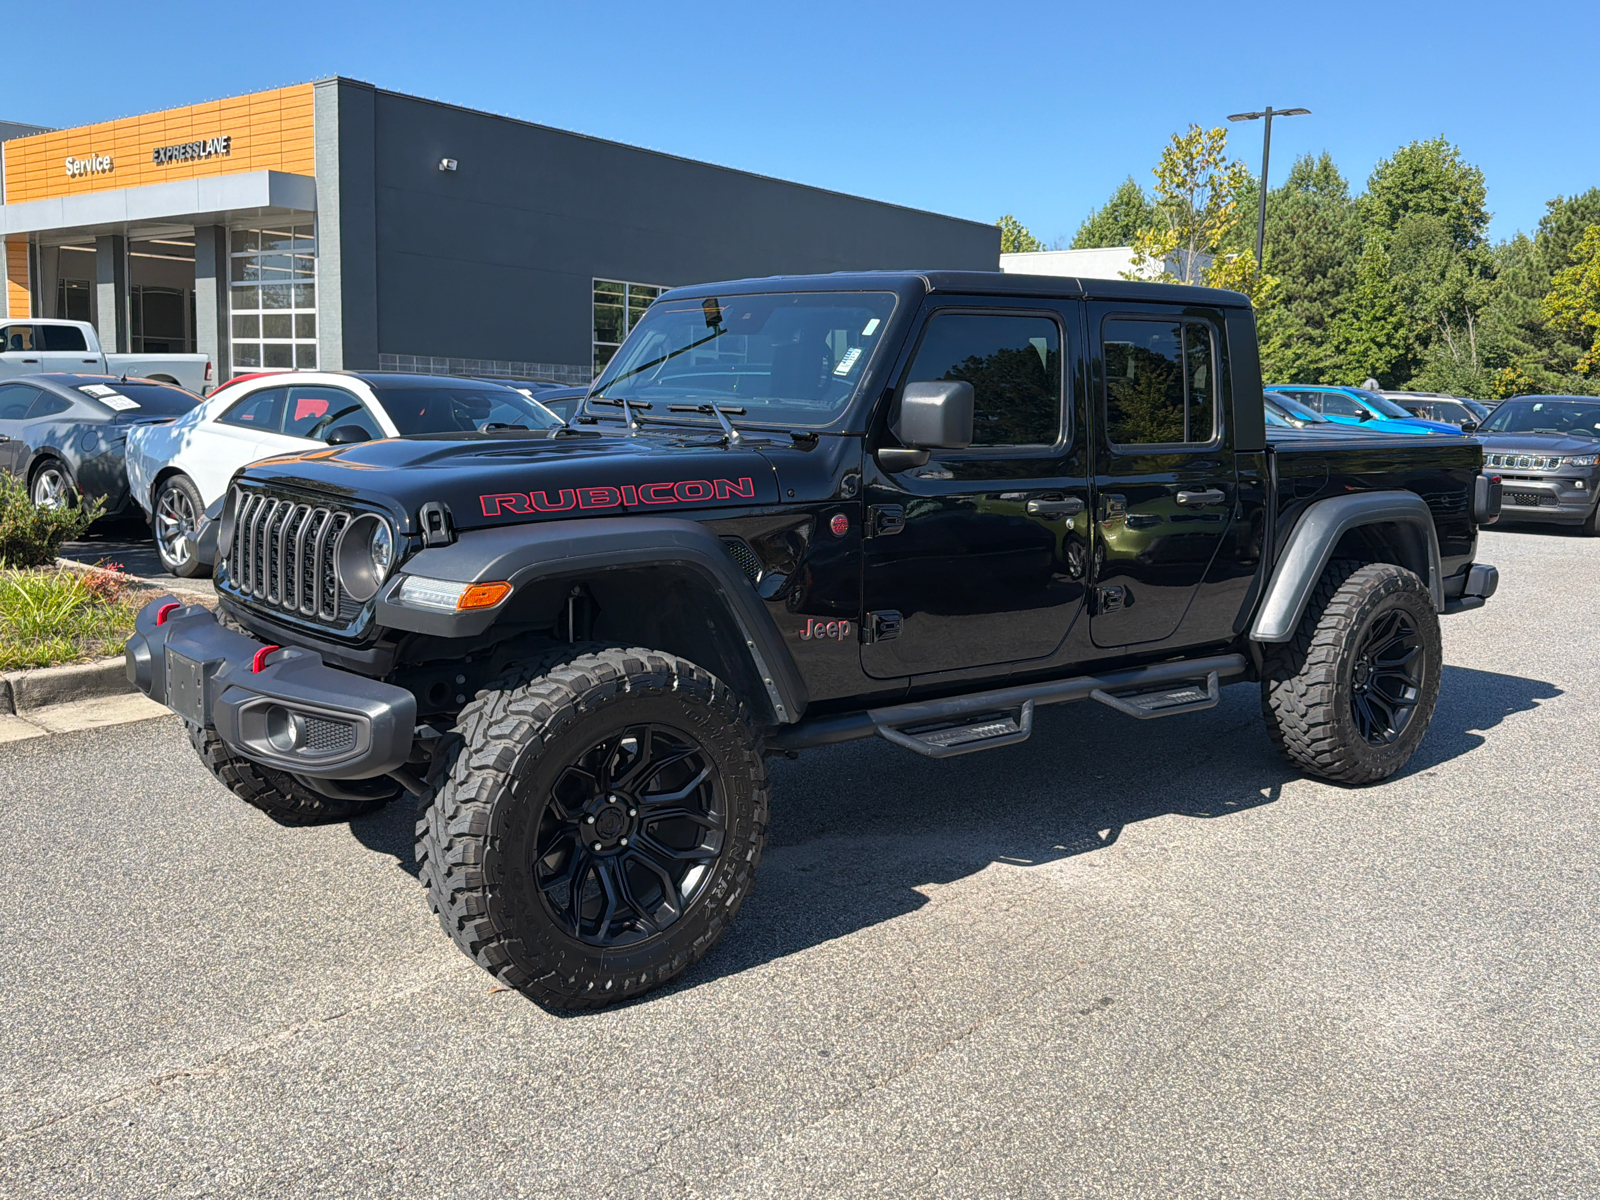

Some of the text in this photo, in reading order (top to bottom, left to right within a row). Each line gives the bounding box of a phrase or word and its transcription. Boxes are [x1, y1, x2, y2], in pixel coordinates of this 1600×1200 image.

[65, 153, 112, 176] Service
[479, 477, 755, 517] RUBICON
[800, 618, 851, 641] Jeep
[704, 773, 749, 919] COUNTRY
